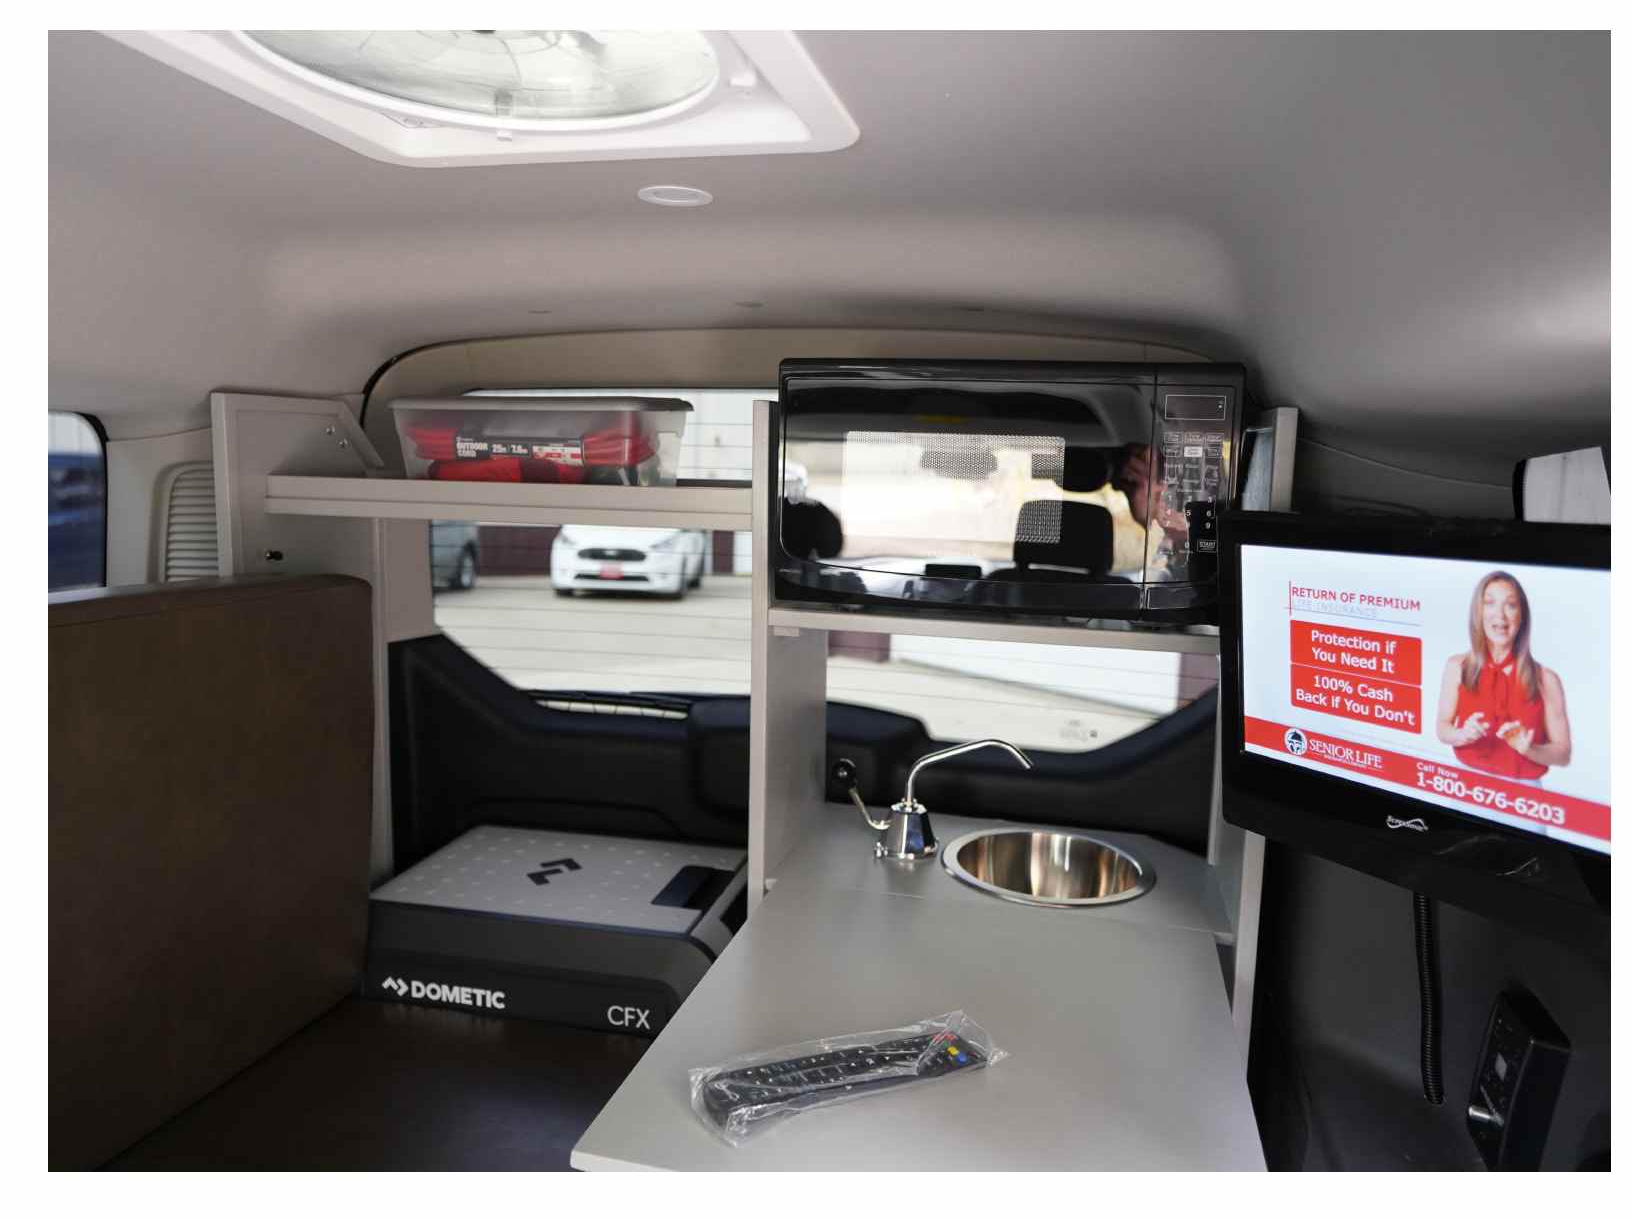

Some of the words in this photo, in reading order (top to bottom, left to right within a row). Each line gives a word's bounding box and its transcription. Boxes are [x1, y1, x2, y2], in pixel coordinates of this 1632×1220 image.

[1291, 586, 1336, 601] RETURN
[1340, 592, 1357, 603] OF
[1360, 594, 1420, 611] PREMIUM
[1311, 629, 1380, 653] Protection
[1385, 640, 1396, 654] if
[1312, 647, 1336, 663] You
[1340, 652, 1377, 670] Need
[1381, 658, 1395, 673] It
[1313, 675, 1353, 695] 100%
[1357, 683, 1393, 702] Cash
[1296, 688, 1327, 706] Back
[1331, 696, 1341, 709] if
[1344, 698, 1369, 716] You
[1374, 705, 1415, 726] Don't
[1309, 739, 1354, 759] SENIOR
[1355, 750, 1384, 769] LIFE
[1416, 762, 1435, 773] Call
[1416, 772, 1565, 824] 1-800-676-6203
[411, 979, 506, 1010] DOMETIC
[607, 1005, 651, 1030] CFX
